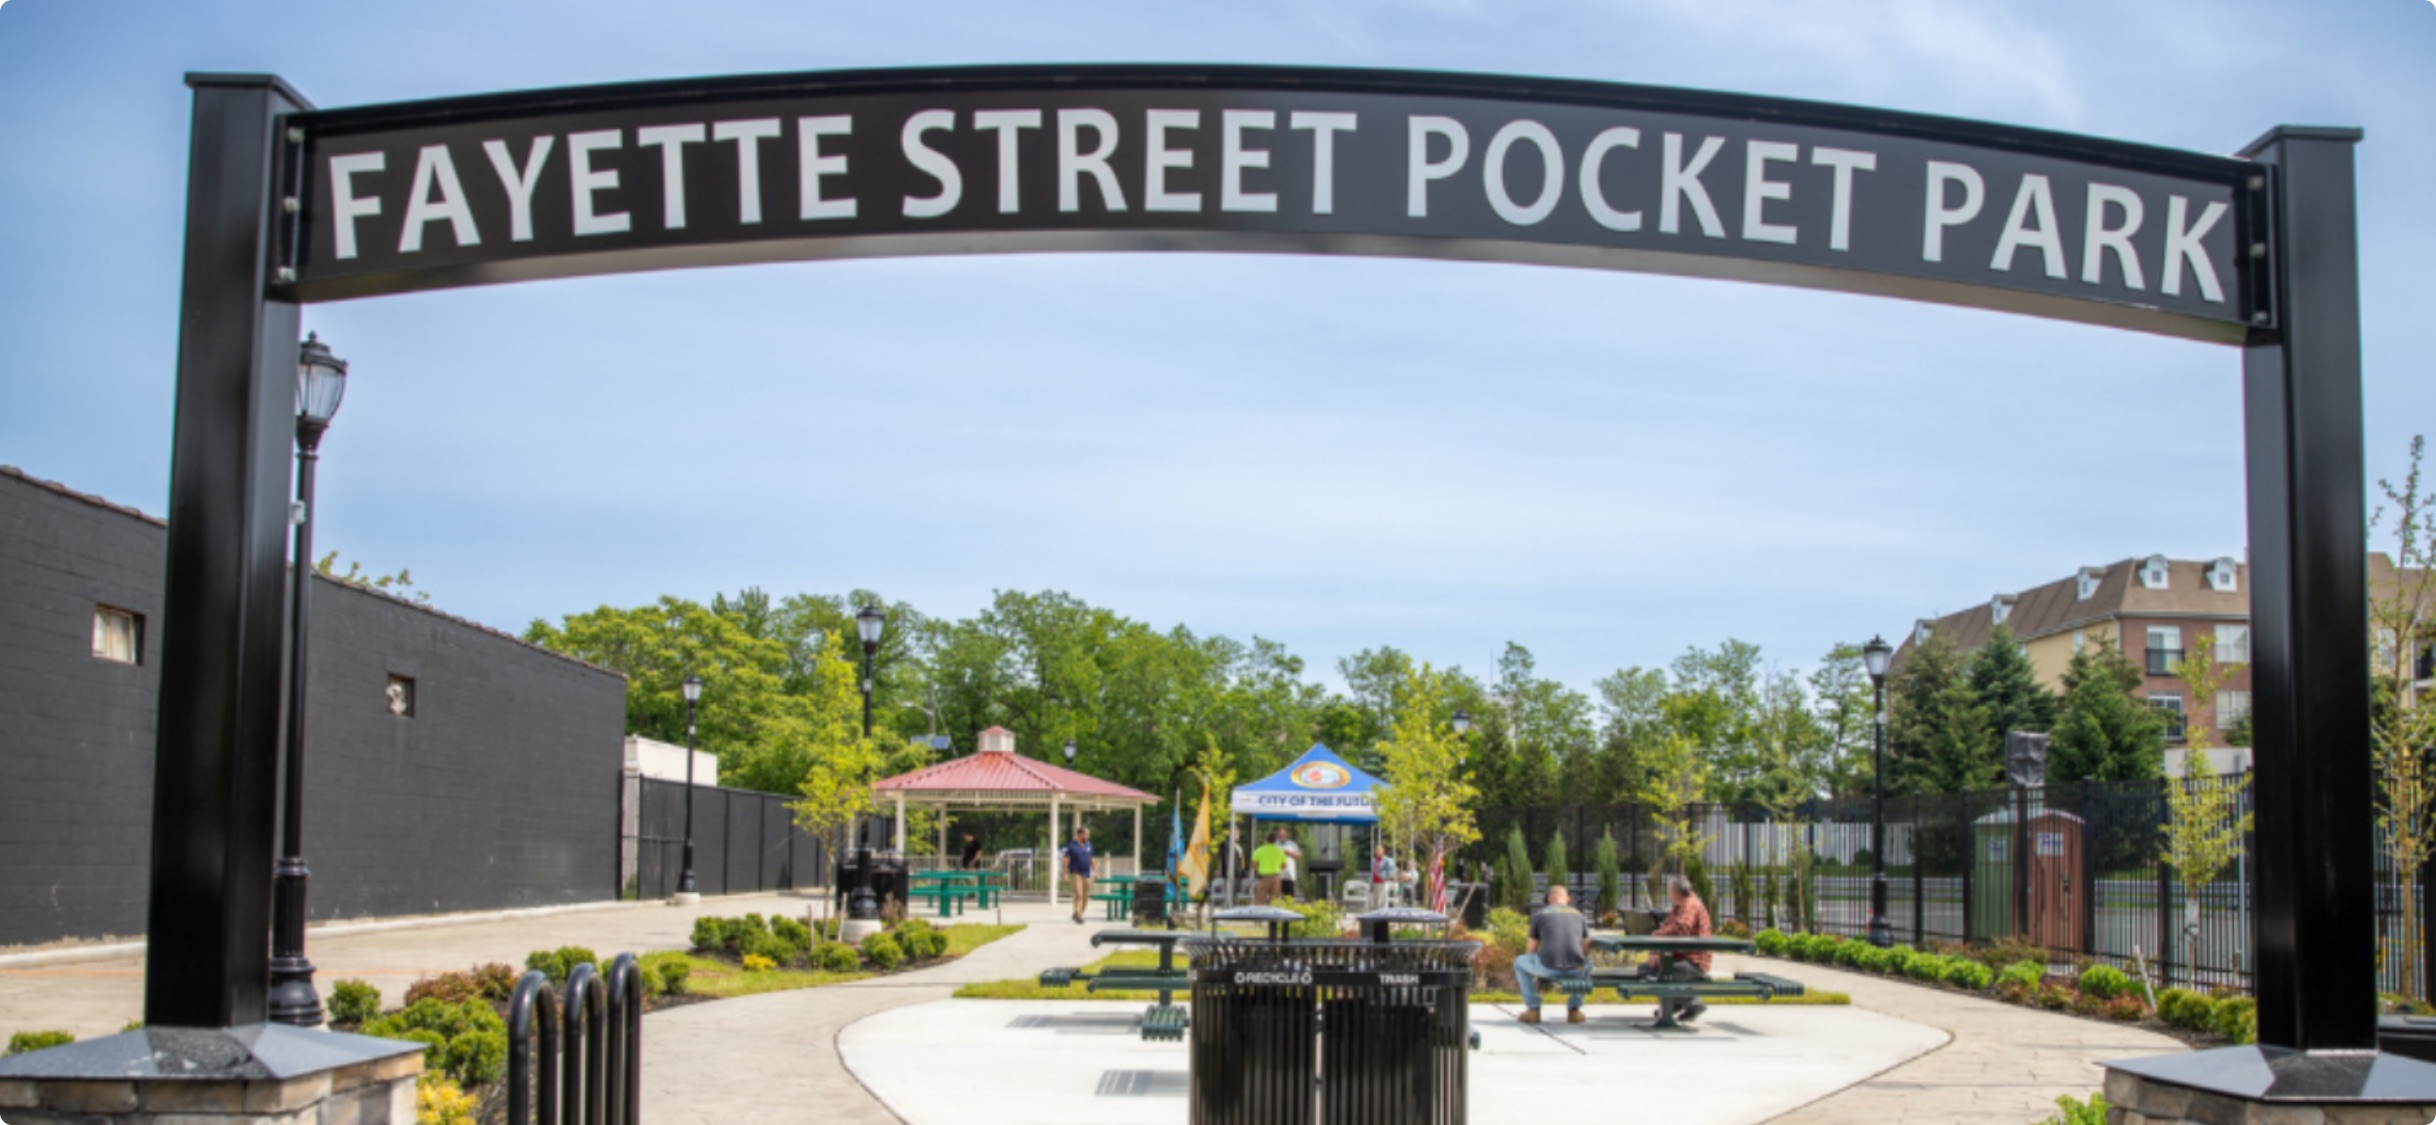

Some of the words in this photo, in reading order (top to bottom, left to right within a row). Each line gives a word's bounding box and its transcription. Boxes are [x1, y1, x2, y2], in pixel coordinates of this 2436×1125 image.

[329, 114, 858, 260] FAYETTE
[901, 108, 1358, 217] STREET
[1407, 114, 1877, 252] POCKET
[1921, 160, 2230, 303] PARK
[1258, 794, 1286, 806] CITY
[1288, 795, 1306, 806] OF
[1310, 795, 1333, 806] THE
[1245, 971, 1300, 984] RECYCLE
[1379, 973, 1420, 985] TRASH
